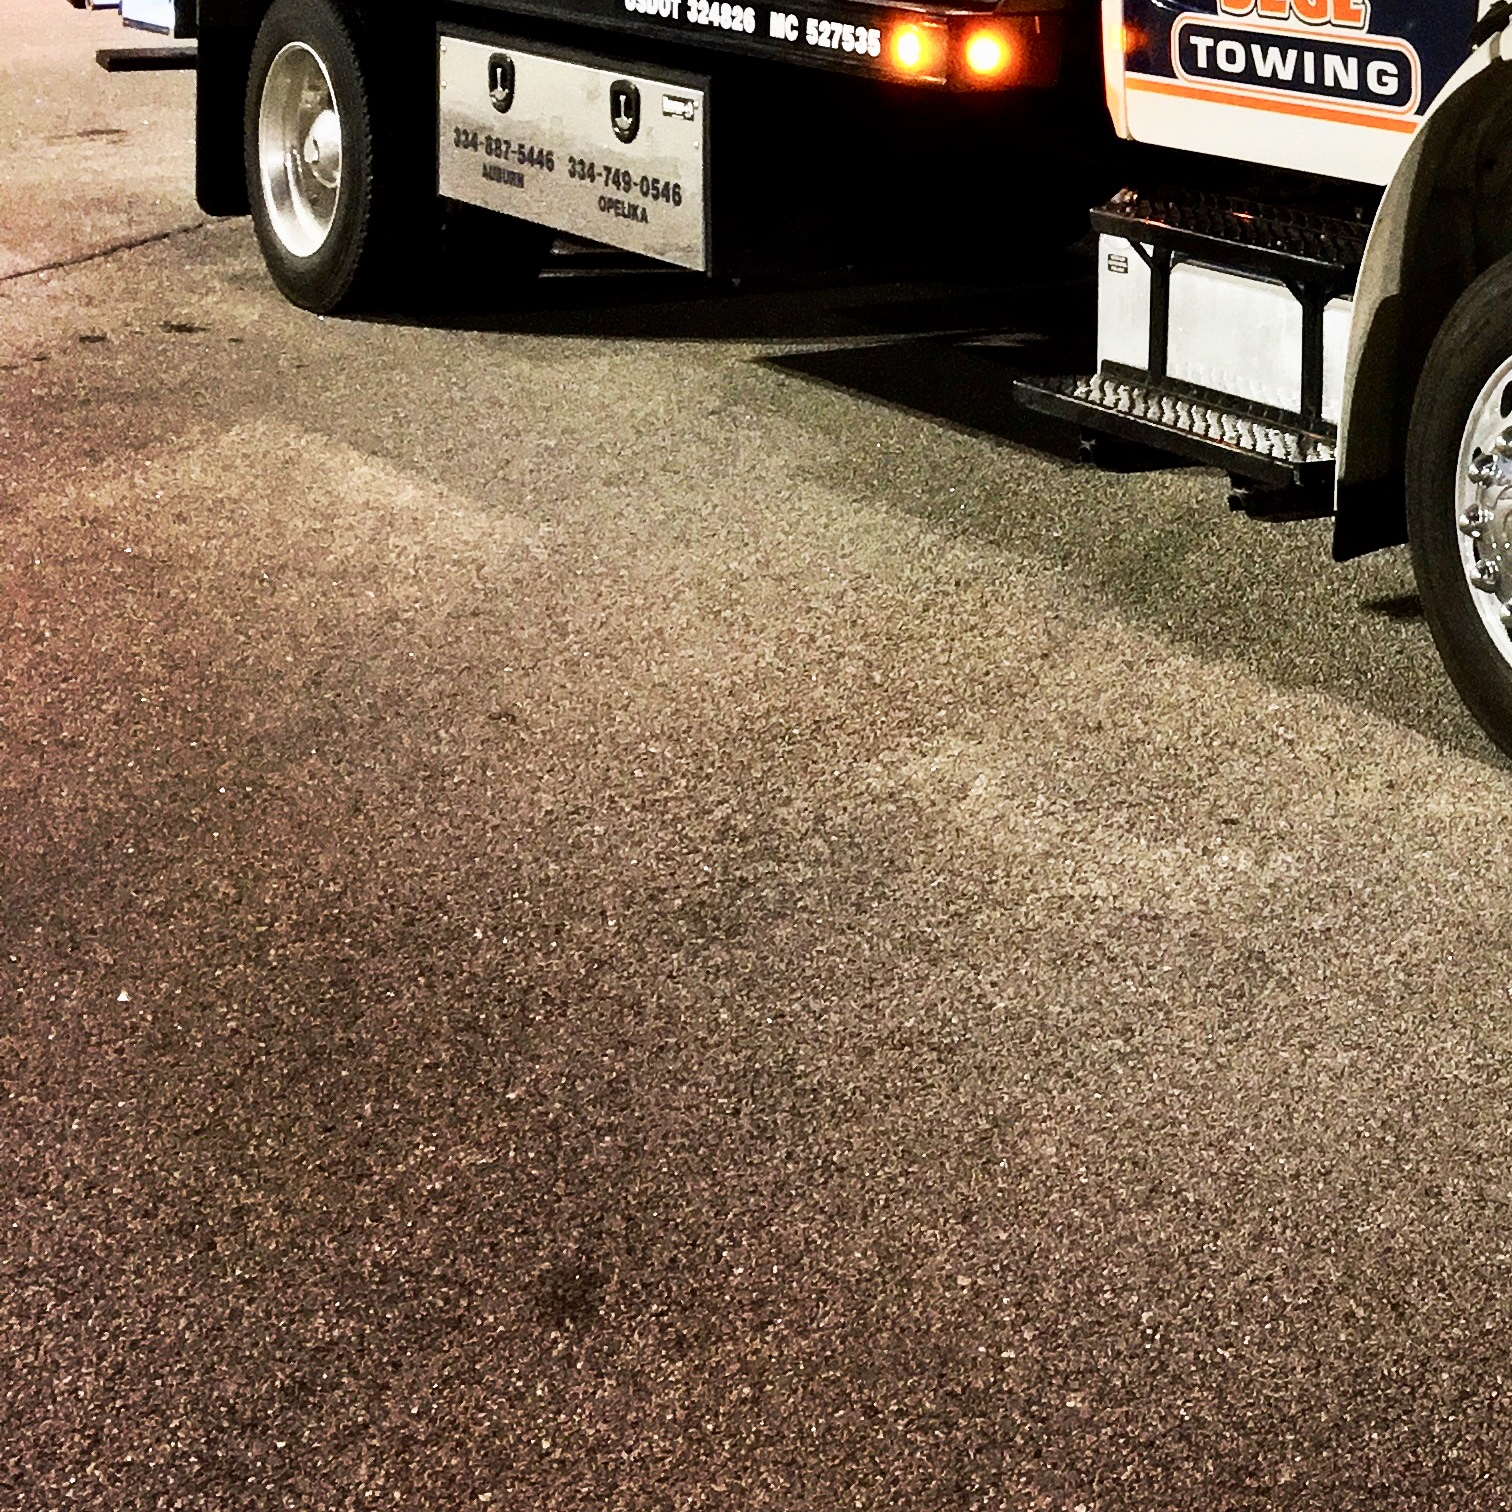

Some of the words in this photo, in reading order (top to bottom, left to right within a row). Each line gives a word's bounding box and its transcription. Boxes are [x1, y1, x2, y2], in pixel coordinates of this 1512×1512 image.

[769, 11, 799, 41] MC
[805, 17, 881, 57] 527535
[1189, 35, 1399, 97] TOWING
[567, 155, 683, 207] 334-749-0546
